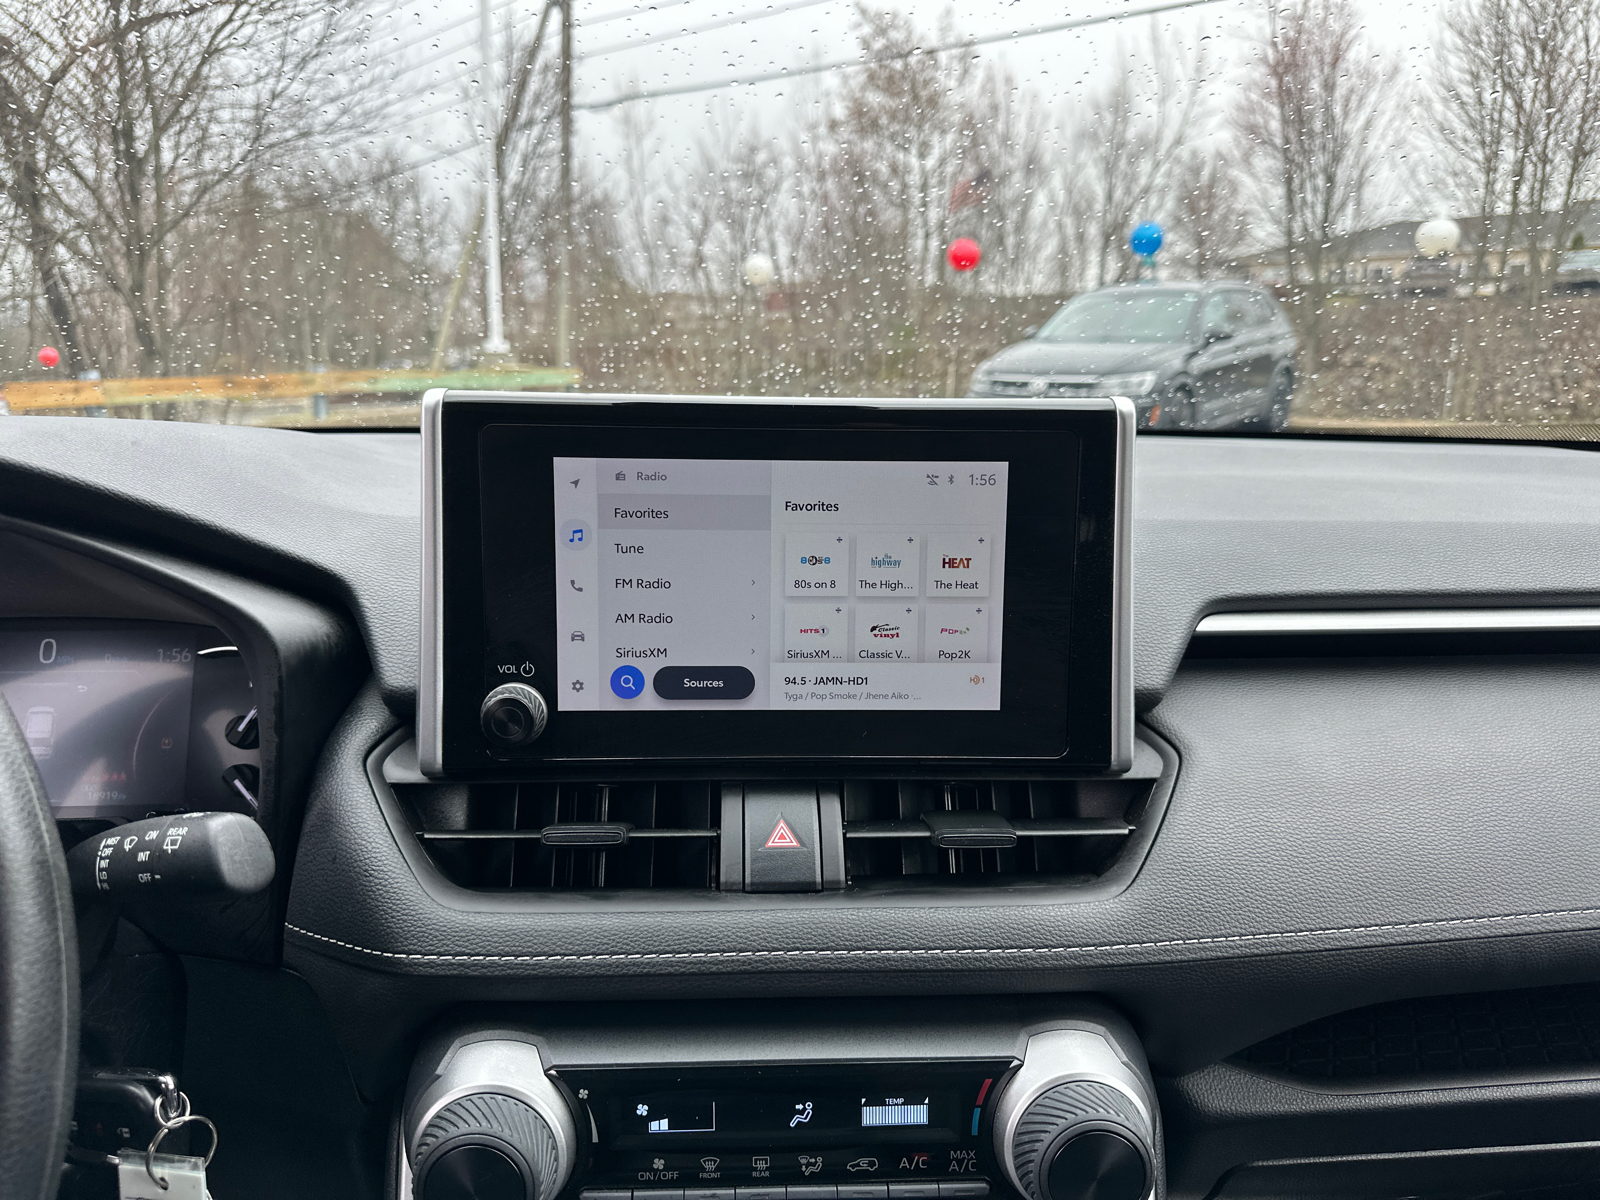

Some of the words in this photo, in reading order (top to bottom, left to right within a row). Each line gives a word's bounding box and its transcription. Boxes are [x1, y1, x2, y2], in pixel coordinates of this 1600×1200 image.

[636, 471, 667, 481] Radio
[968, 473, 996, 486] 1:56
[785, 501, 839, 512] Favorites
[614, 507, 669, 519] Favorites
[614, 543, 644, 554] Tune
[871, 556, 901, 568] highway
[942, 558, 972, 568] HEAT
[615, 578, 633, 589] FM
[637, 578, 671, 589] Radio
[794, 579, 812, 589] 80s
[814, 581, 827, 589] on
[829, 579, 836, 589] 8
[858, 579, 877, 589] The
[934, 580, 952, 589] The
[955, 580, 979, 589] Heat
[615, 613, 634, 624] AM
[638, 613, 673, 624] Radio
[39, 638, 57, 664] 0
[157, 648, 192, 662] 1:56
[615, 647, 668, 658] SiriusXM
[787, 649, 830, 659] SiriusXM
[858, 649, 893, 659] Classic
[938, 650, 971, 661] Pop2K
[497, 664, 518, 674] VOL
[683, 678, 724, 688] Sources
[784, 676, 807, 686] 94.5
[813, 676, 869, 686] JAMN-HD1
[784, 692, 803, 702] Tyga
[810, 692, 829, 701] Pop
[829, 692, 857, 700] Smoke
[865, 692, 890, 700] Jhene
[891, 692, 909, 700] Aiko
[145, 830, 160, 841] ON
[167, 827, 188, 836] REAR
[102, 847, 114, 857] OFF
[138, 851, 150, 862] INT
[100, 859, 110, 868] INT
[100, 871, 107, 880] LO
[138, 873, 152, 882] OFF
[950, 1149, 976, 1159] MAX
[899, 1156, 928, 1170] A/C
[948, 1159, 977, 1173] A/C
[637, 1171, 679, 1181] ON/OFF
